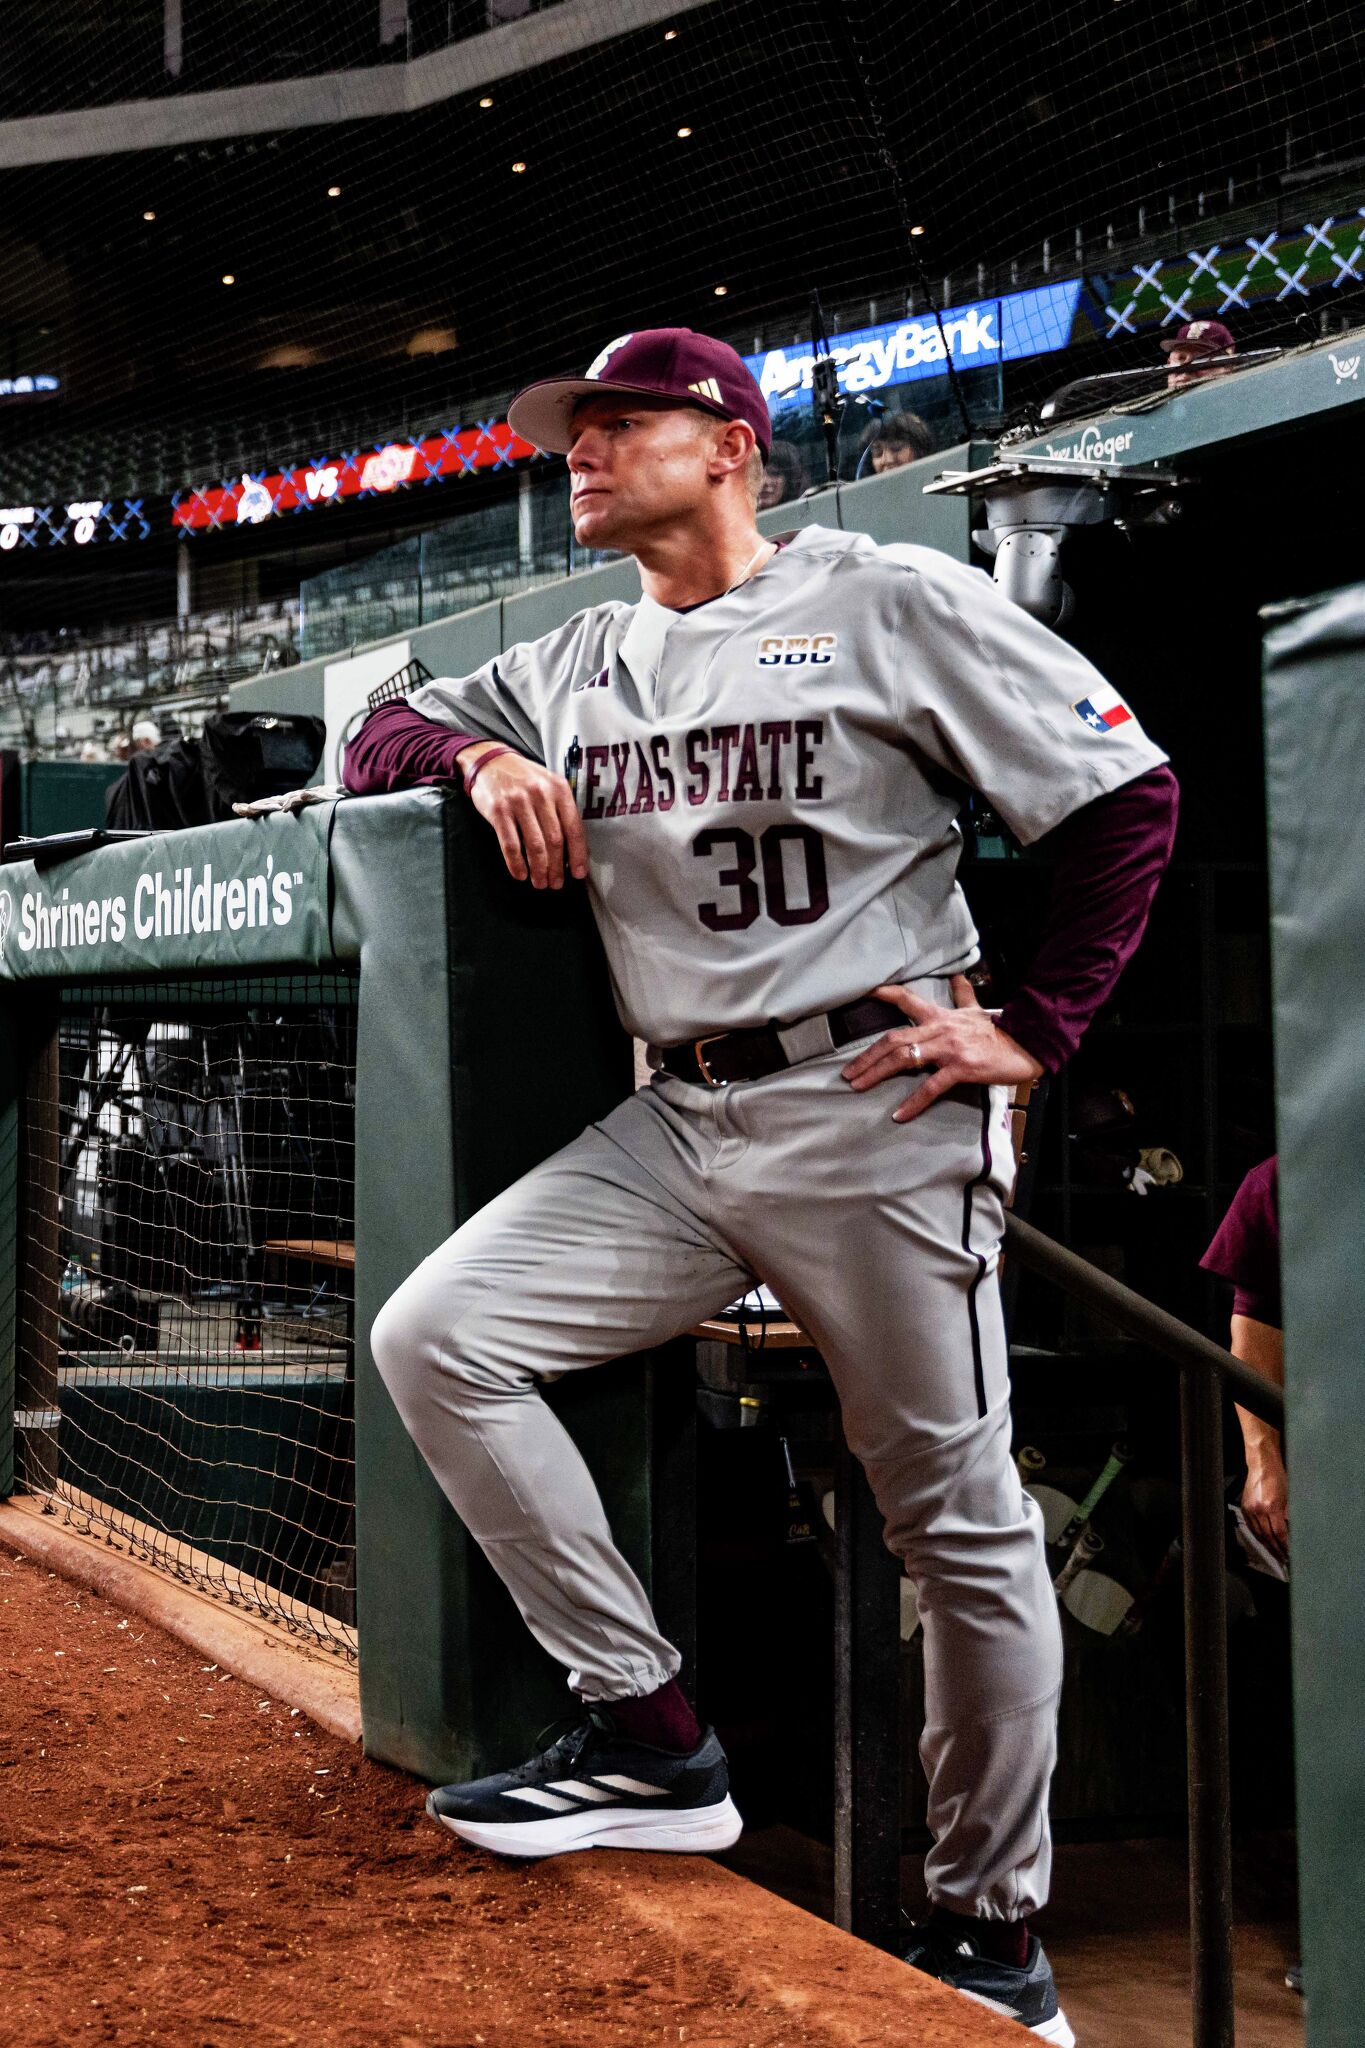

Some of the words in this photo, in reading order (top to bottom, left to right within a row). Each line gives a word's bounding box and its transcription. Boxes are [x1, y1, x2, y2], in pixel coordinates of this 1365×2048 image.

[1074, 426, 1133, 464] Kroger
[74, 517, 95, 544] 0
[758, 635, 835, 666] SBC
[576, 735, 676, 820] EXAS
[685, 720, 823, 806] STATE
[692, 824, 830, 932] 30
[18, 887, 126, 951] Shriners
